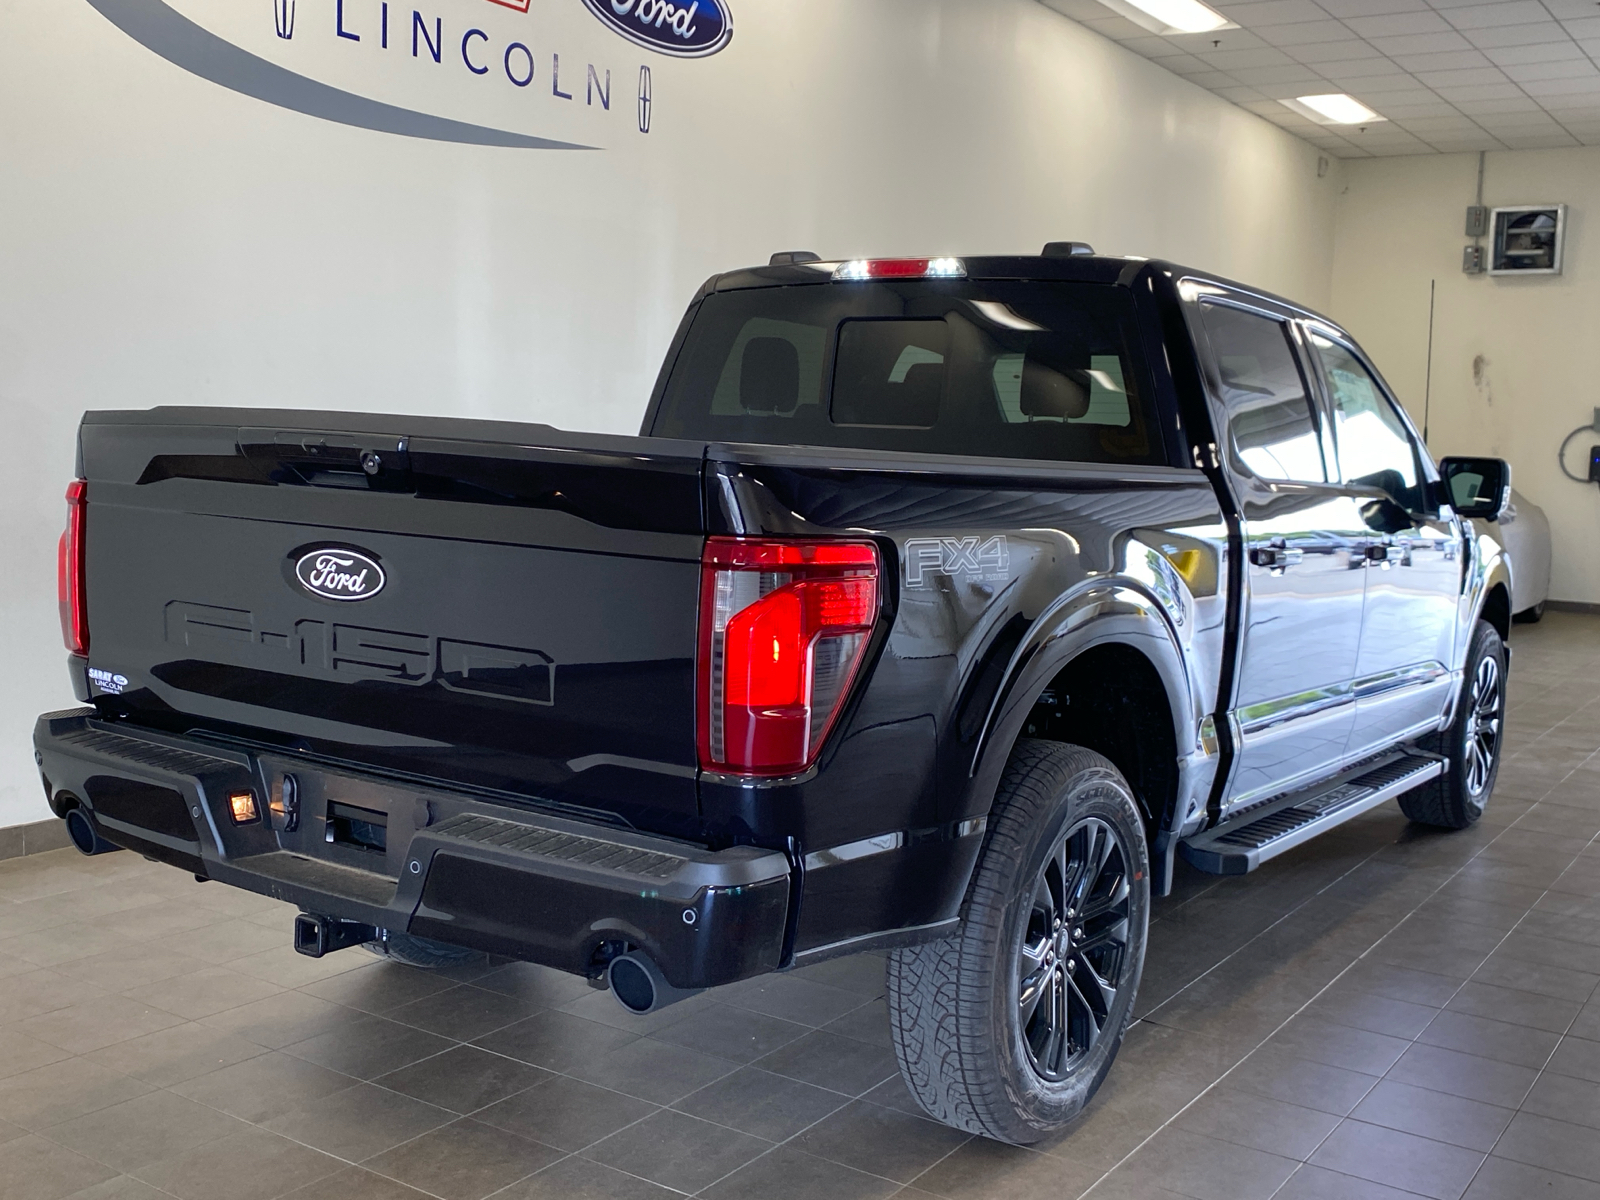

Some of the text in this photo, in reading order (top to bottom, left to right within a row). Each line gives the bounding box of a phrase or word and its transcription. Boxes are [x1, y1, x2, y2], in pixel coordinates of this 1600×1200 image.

[336, 0, 611, 111] LINCOLN
[310, 555, 368, 592] Ford
[904, 535, 1009, 587] FX4
[163, 600, 556, 707] F-150
[94, 678, 123, 691] LINCOLN
